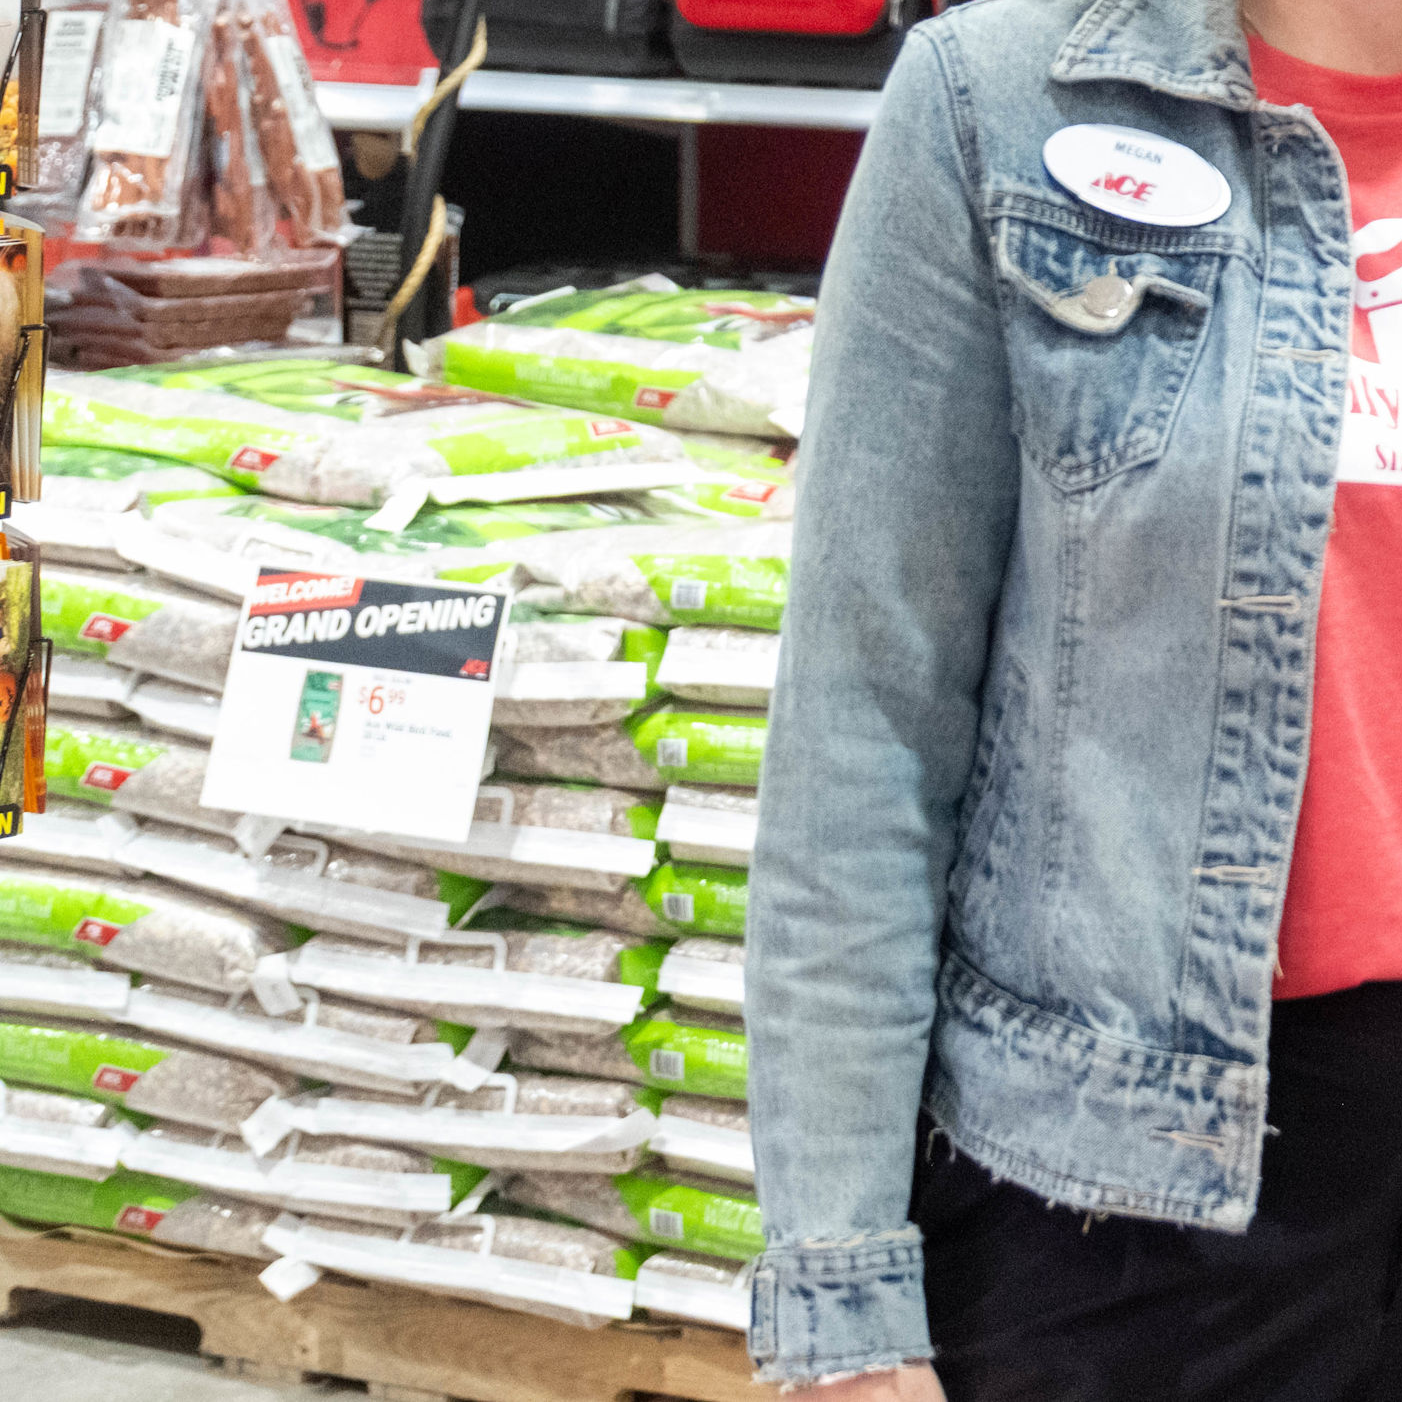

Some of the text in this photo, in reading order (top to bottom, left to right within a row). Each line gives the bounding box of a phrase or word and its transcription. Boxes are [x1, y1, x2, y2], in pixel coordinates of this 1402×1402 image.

[1114, 141, 1164, 165] MEGAN
[1090, 171, 1158, 202] ACE
[243, 594, 497, 649] GRAND OPENING
